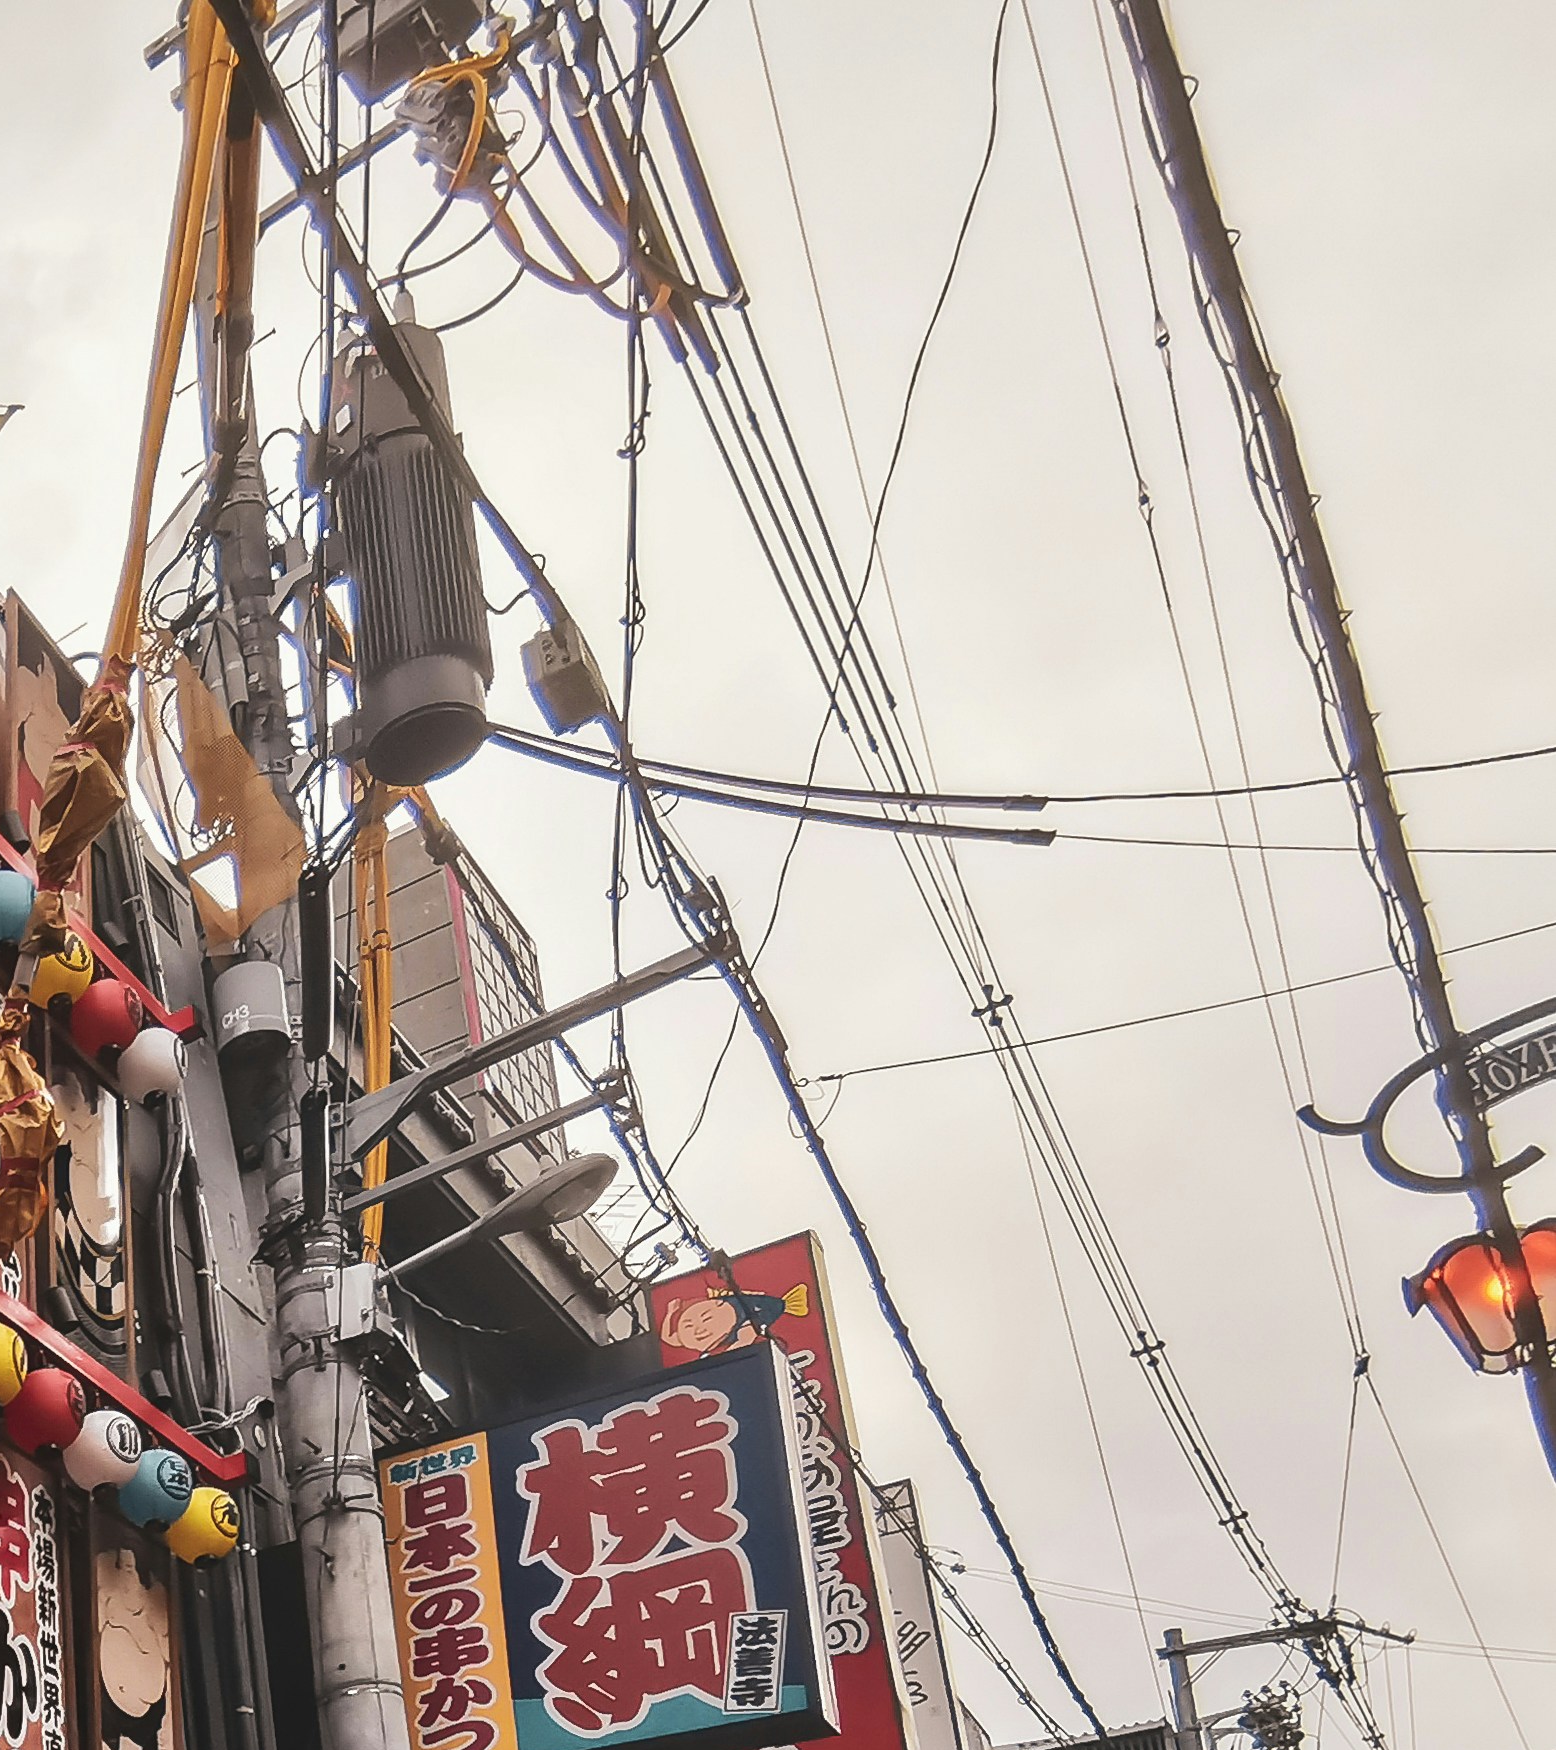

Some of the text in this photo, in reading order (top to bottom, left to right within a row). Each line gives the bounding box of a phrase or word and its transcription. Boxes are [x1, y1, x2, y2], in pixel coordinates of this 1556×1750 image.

[389, 1443, 478, 1485] 新世界
[516, 1384, 757, 1738] 横綱
[731, 1616, 780, 1708] 法善寺
